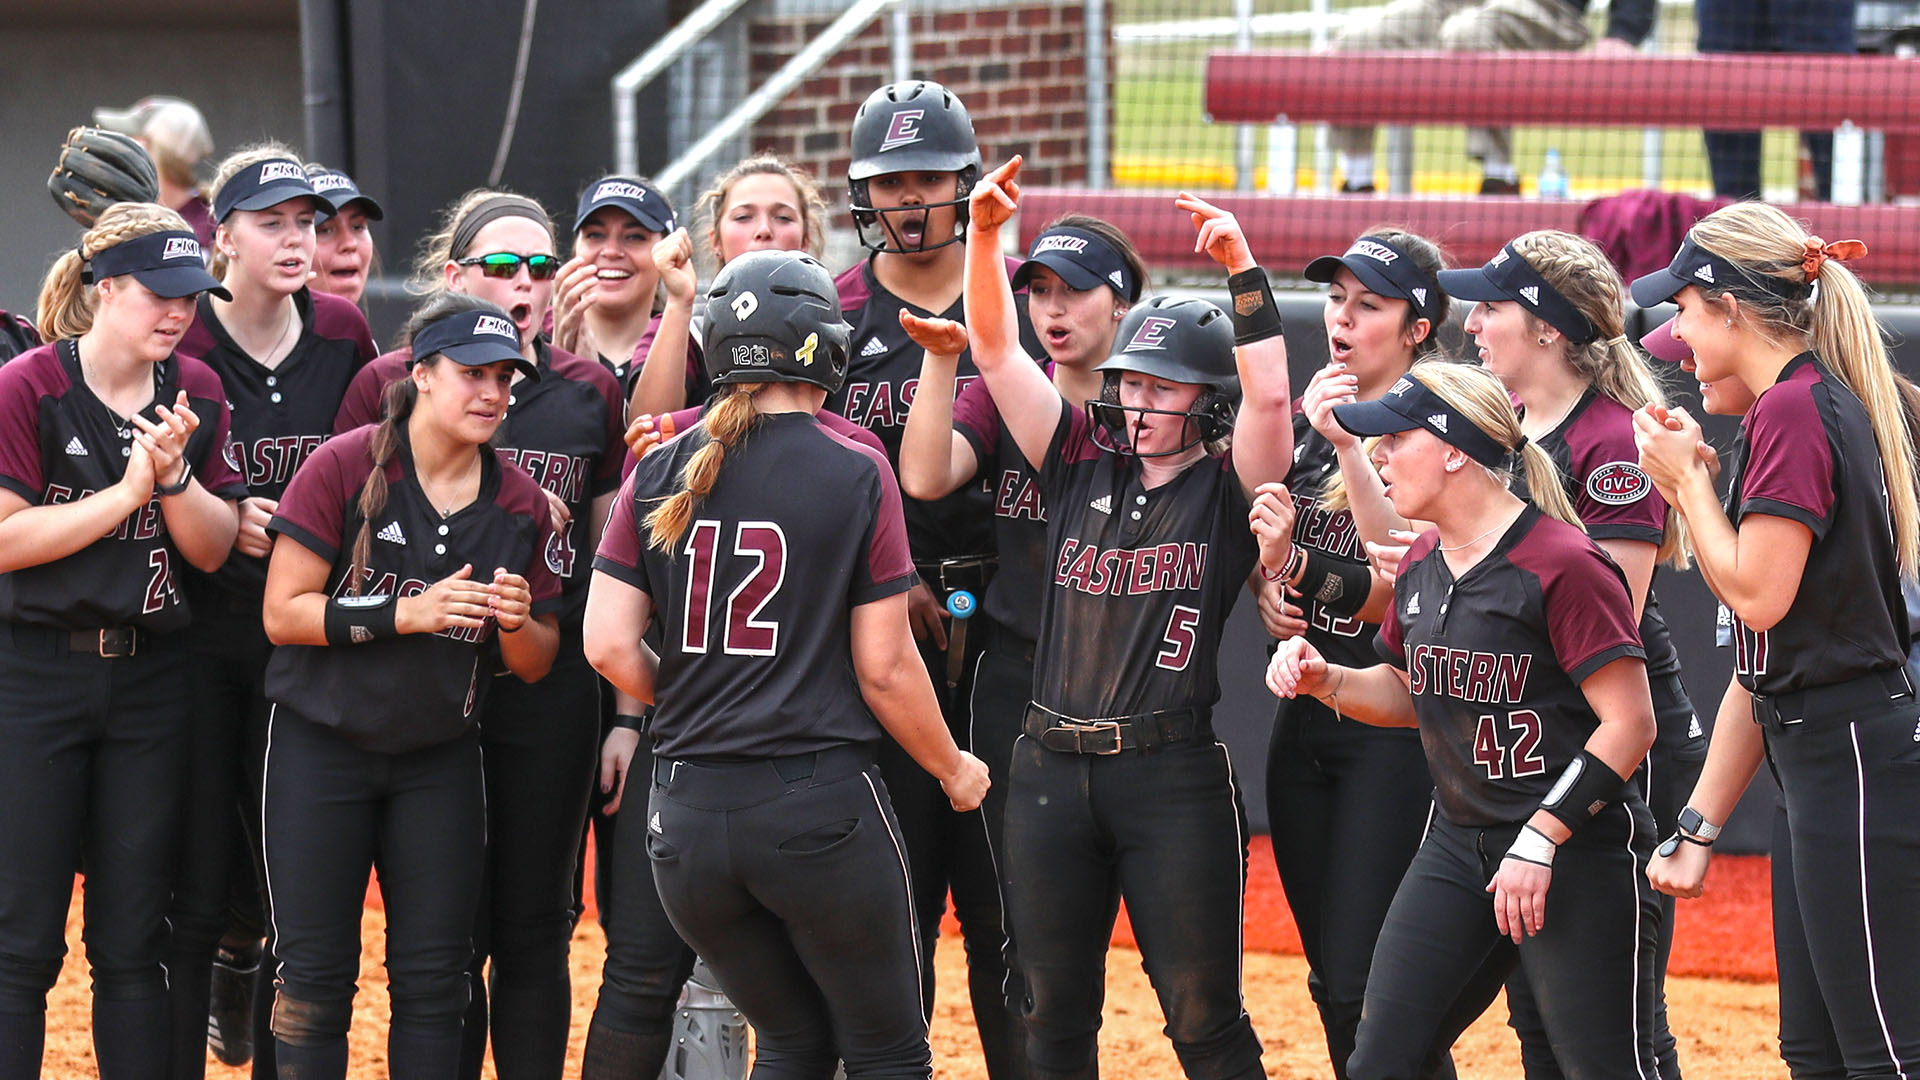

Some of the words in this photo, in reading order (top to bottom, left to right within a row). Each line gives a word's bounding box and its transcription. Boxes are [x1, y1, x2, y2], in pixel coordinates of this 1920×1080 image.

[883, 109, 925, 146] E
[592, 182, 646, 204] EKU
[1032, 235, 1089, 258] EKU
[1128, 316, 1177, 348] E
[732, 345, 751, 366] 12
[377, 531, 407, 546] adidas
[1055, 541, 1208, 596] EASTERN
[682, 520, 788, 657] 12
[1156, 605, 1201, 671] 5
[1404, 642, 1533, 704] STERN
[1473, 709, 1546, 780] 42
